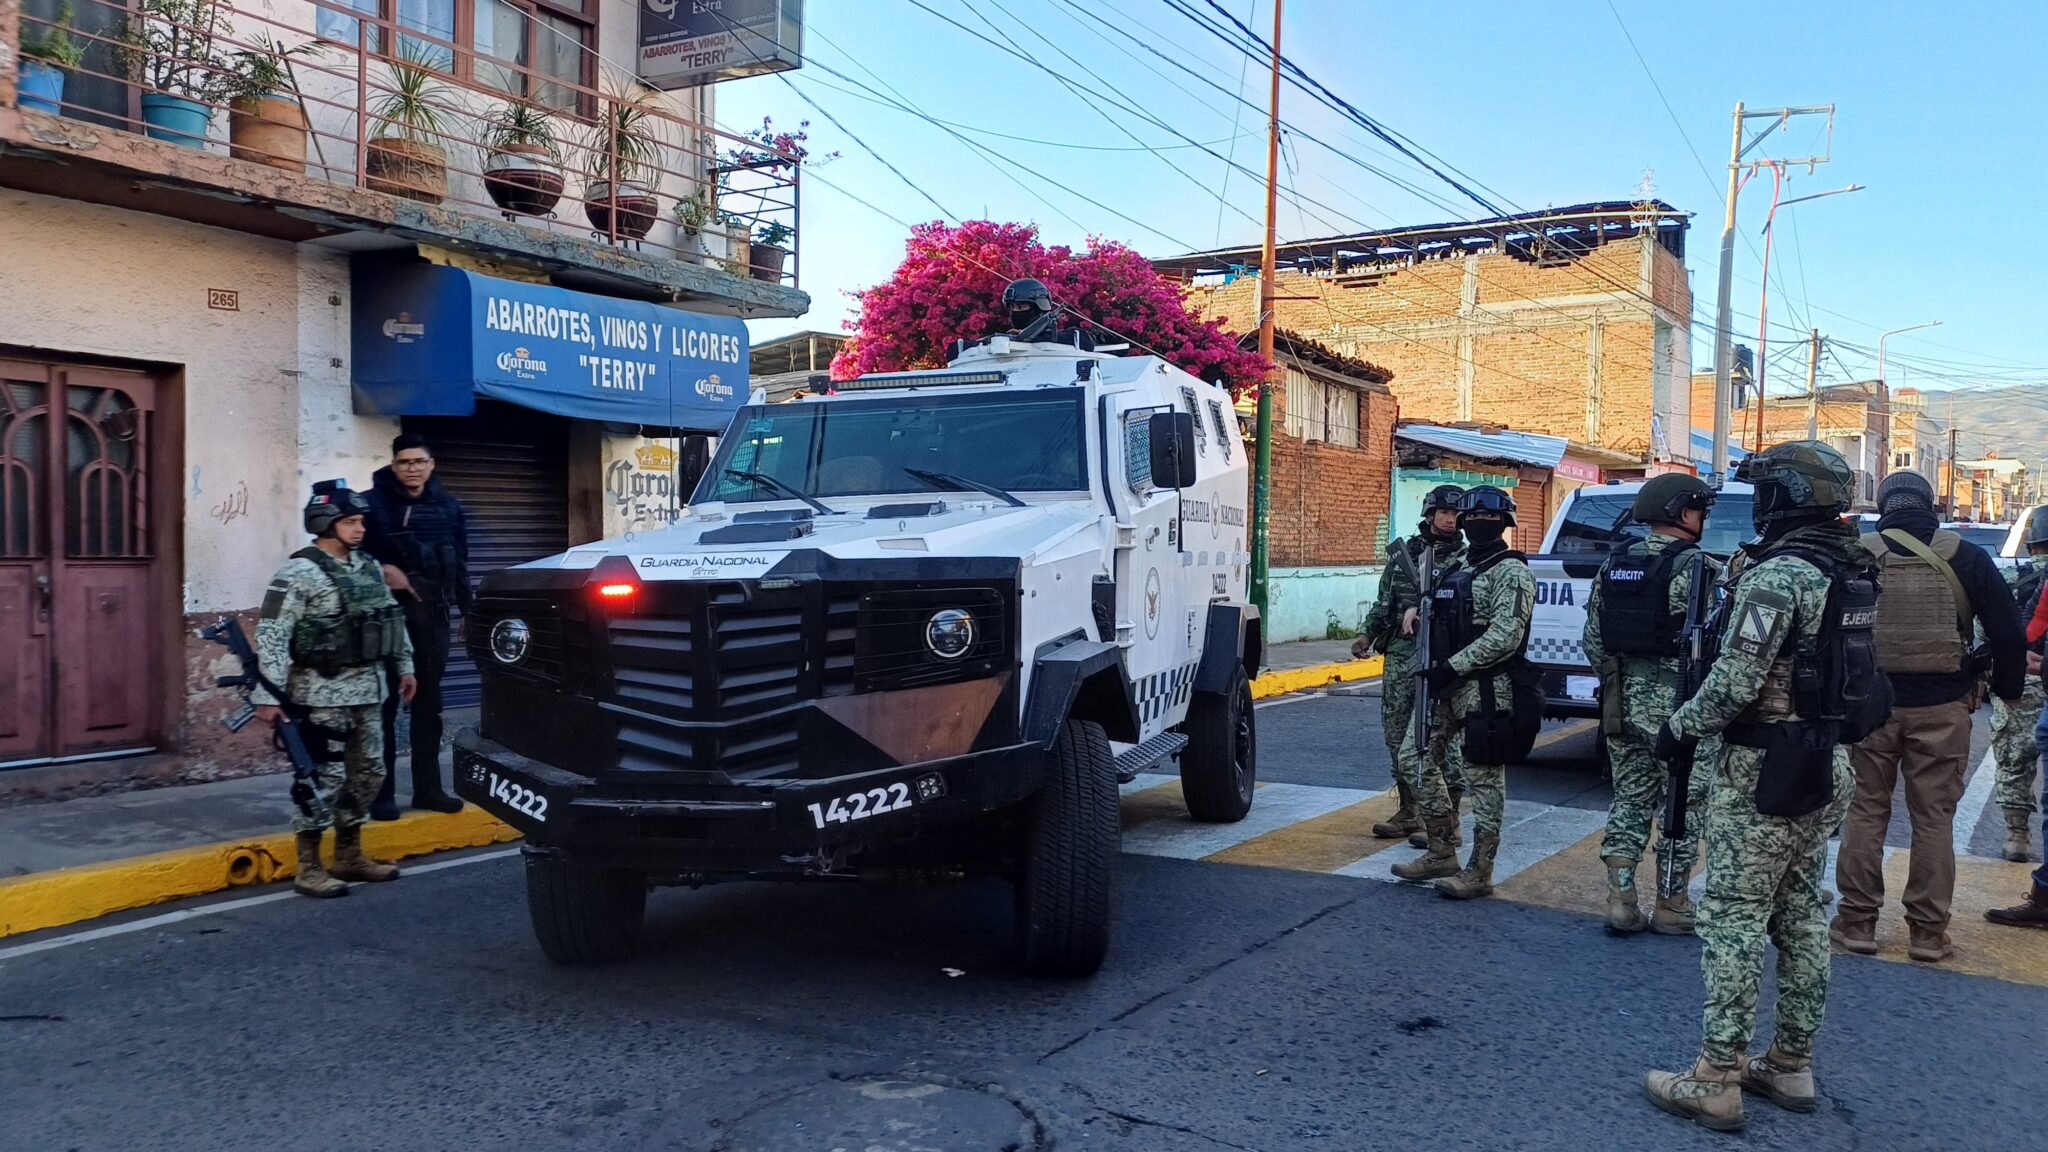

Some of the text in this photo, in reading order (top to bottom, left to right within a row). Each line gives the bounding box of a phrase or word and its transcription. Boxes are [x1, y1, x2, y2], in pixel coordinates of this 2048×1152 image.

[642, 40, 697, 60] ABARROTES,
[698, 33, 726, 49] VINOS
[212, 292, 235, 307] 265
[486, 296, 739, 364] ABARROTES, VINOS Y LICORES
[496, 351, 547, 373] Corona
[516, 369, 536, 380] Extra
[580, 354, 656, 392] "TERRY"
[694, 378, 733, 397] Corona
[1181, 499, 1244, 527] GUARDIA NACIONAL
[488, 773, 549, 822] 14222
[807, 782, 914, 829] 14222
